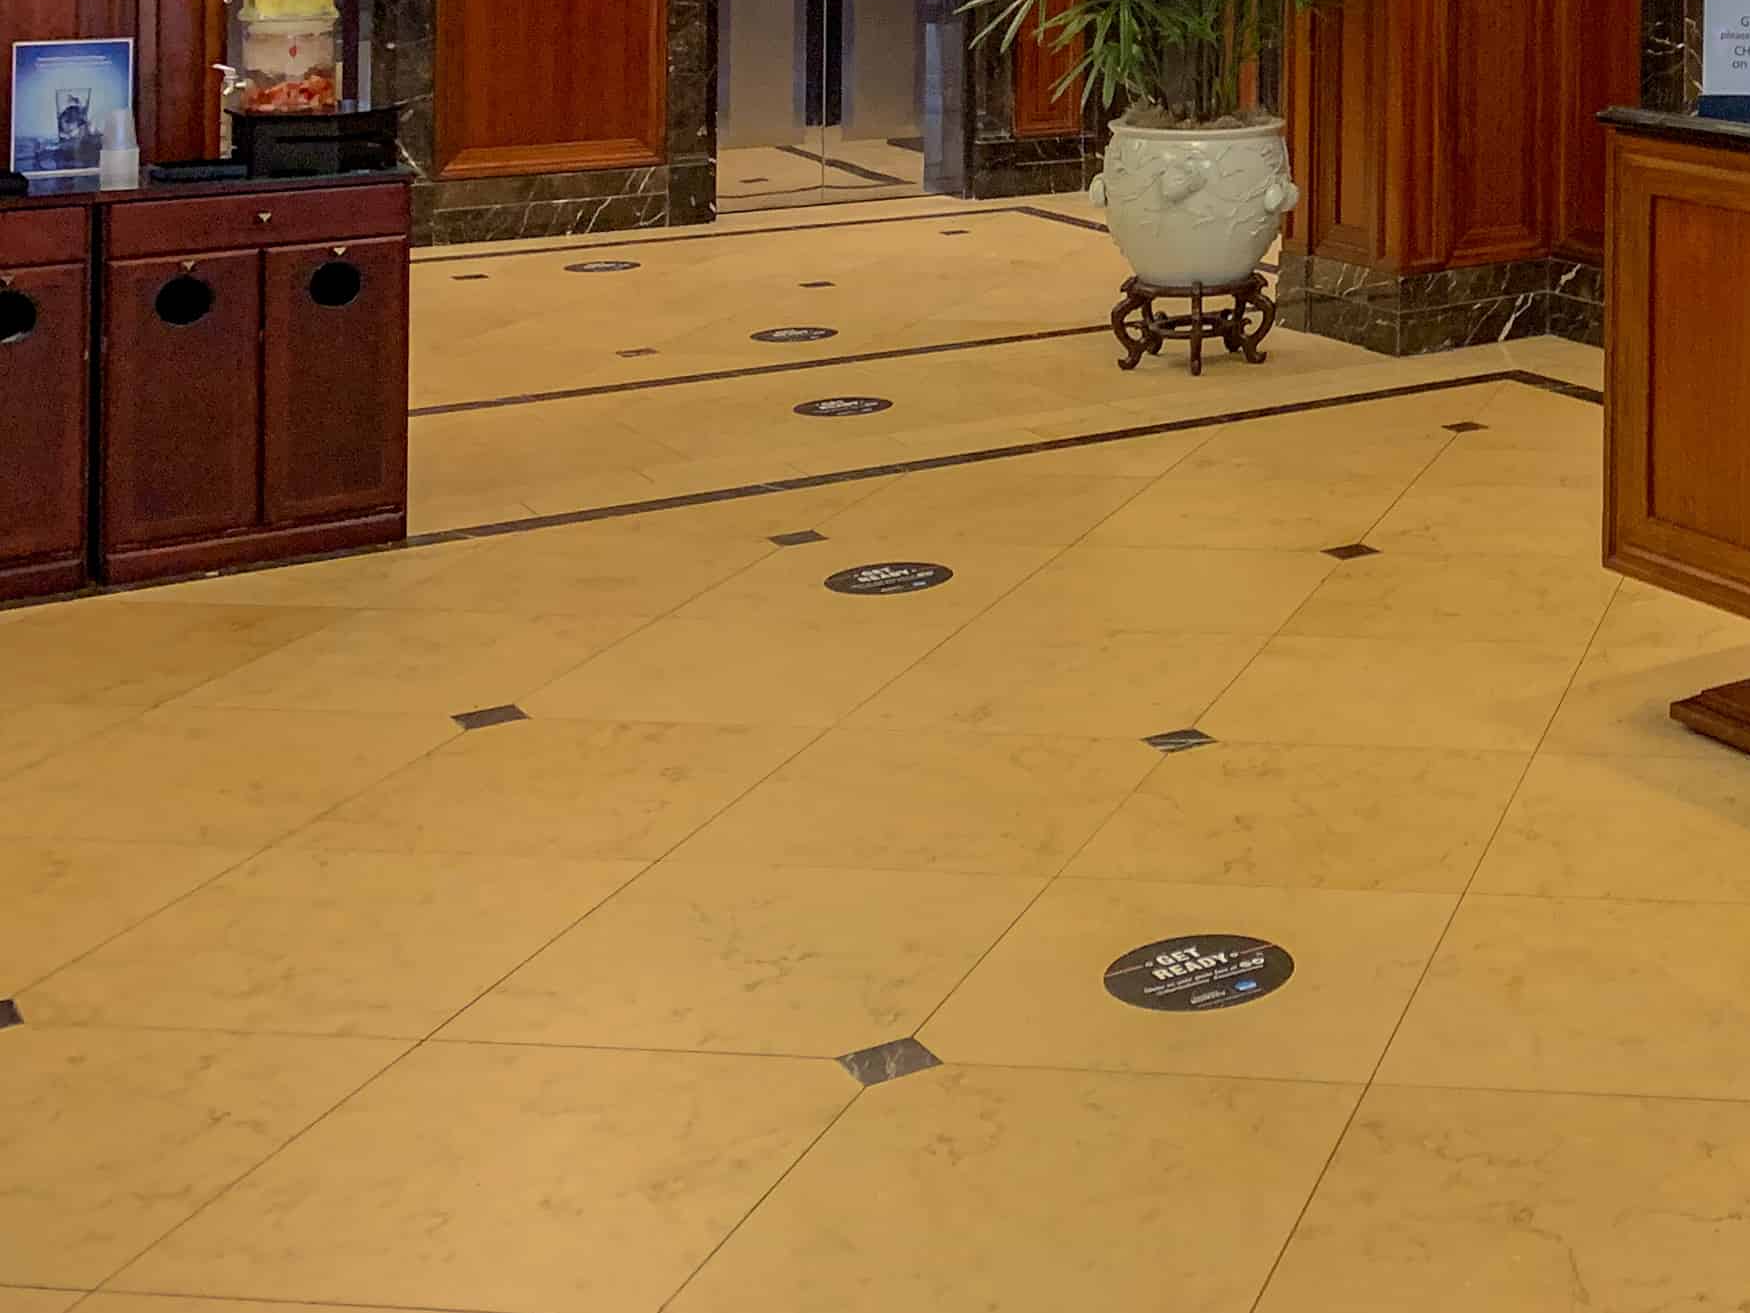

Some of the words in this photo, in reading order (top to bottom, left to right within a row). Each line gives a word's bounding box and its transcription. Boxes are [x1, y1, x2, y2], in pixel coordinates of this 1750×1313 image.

[1720, 31, 1750, 41] please
[1732, 60, 1748, 69] on
[1156, 946, 1200, 966] GET
[1152, 953, 1228, 980] READY
